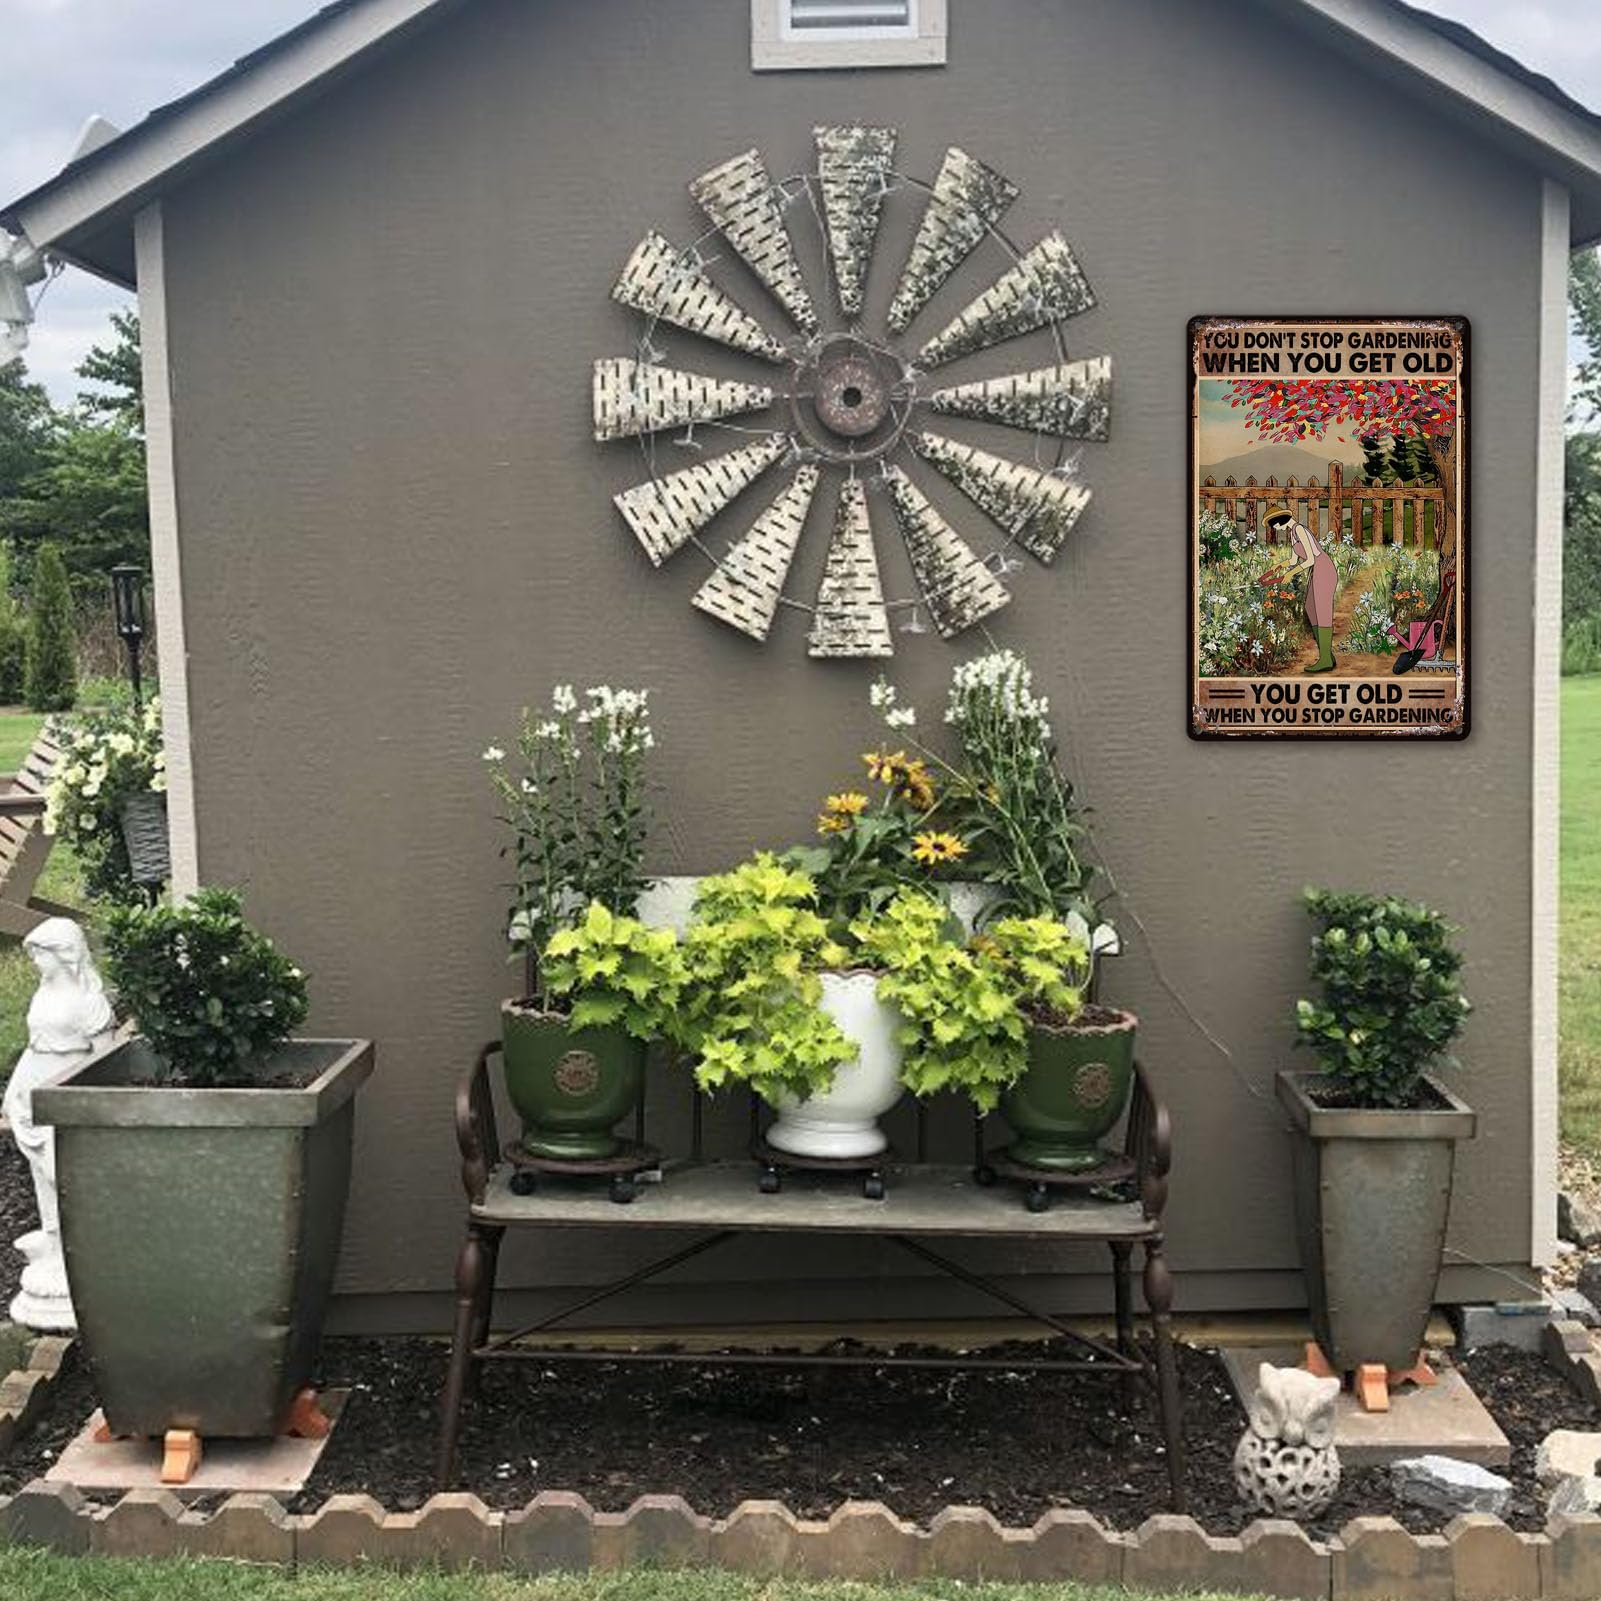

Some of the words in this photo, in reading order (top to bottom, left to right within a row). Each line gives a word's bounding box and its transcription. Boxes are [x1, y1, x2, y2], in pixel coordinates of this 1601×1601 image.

[1204, 332, 1239, 349] YOU
[1243, 332, 1296, 349] DON'T
[1300, 332, 1344, 349] STOP
[1347, 332, 1452, 349] GARDENING
[1204, 353, 1280, 373] WHEN
[1286, 353, 1342, 373] YOU
[1348, 353, 1396, 373] GET
[1402, 353, 1453, 373] OLD
[1250, 683, 1301, 705] YOU
[1307, 683, 1351, 705] GET
[1356, 683, 1403, 705] OLD
[1205, 707, 1256, 724] WHEN
[1260, 707, 1297, 724] YOU
[1301, 707, 1345, 724] STOP
[1349, 707, 1454, 724] GARDENING
